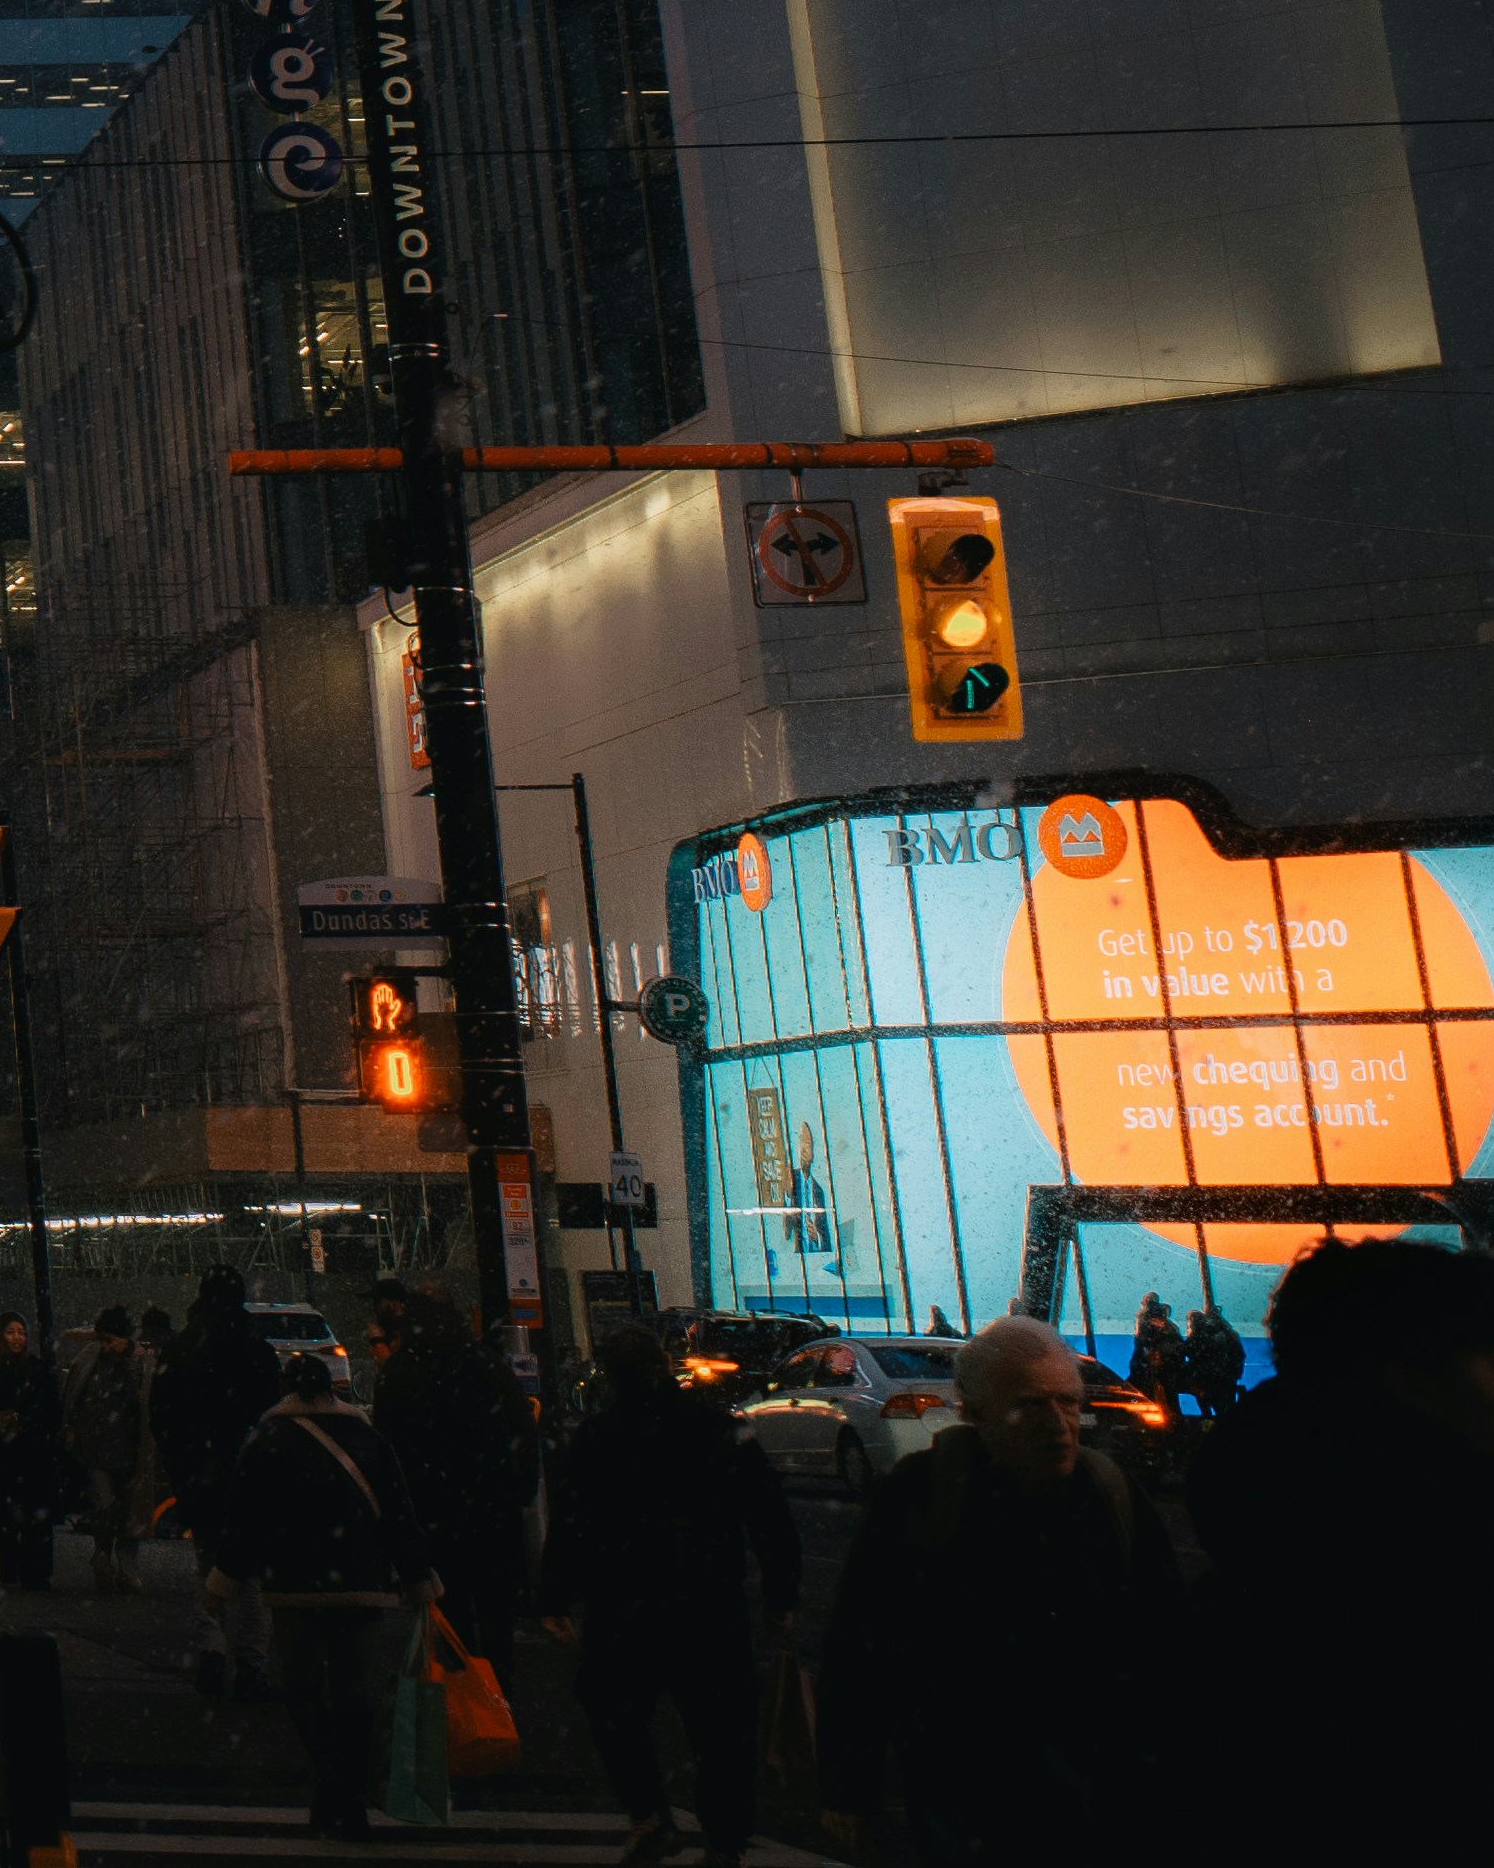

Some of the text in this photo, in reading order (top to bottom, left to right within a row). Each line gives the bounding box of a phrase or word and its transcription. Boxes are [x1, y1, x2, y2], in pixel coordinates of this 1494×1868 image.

[882, 822, 1024, 868] BMO
[690, 863, 739, 905] BMO
[311, 910, 393, 931] Dundas
[1097, 928, 1149, 957] Get
[1203, 925, 1234, 953] to
[1243, 918, 1348, 955] $1200
[1102, 969, 1133, 999] in
[1316, 968, 1335, 992] a
[664, 992, 690, 1019] P
[1116, 1062, 1178, 1087] new
[1349, 1049, 1408, 1082] and
[1121, 1104, 1244, 1136] savngs
[616, 1174, 641, 1197] 40
